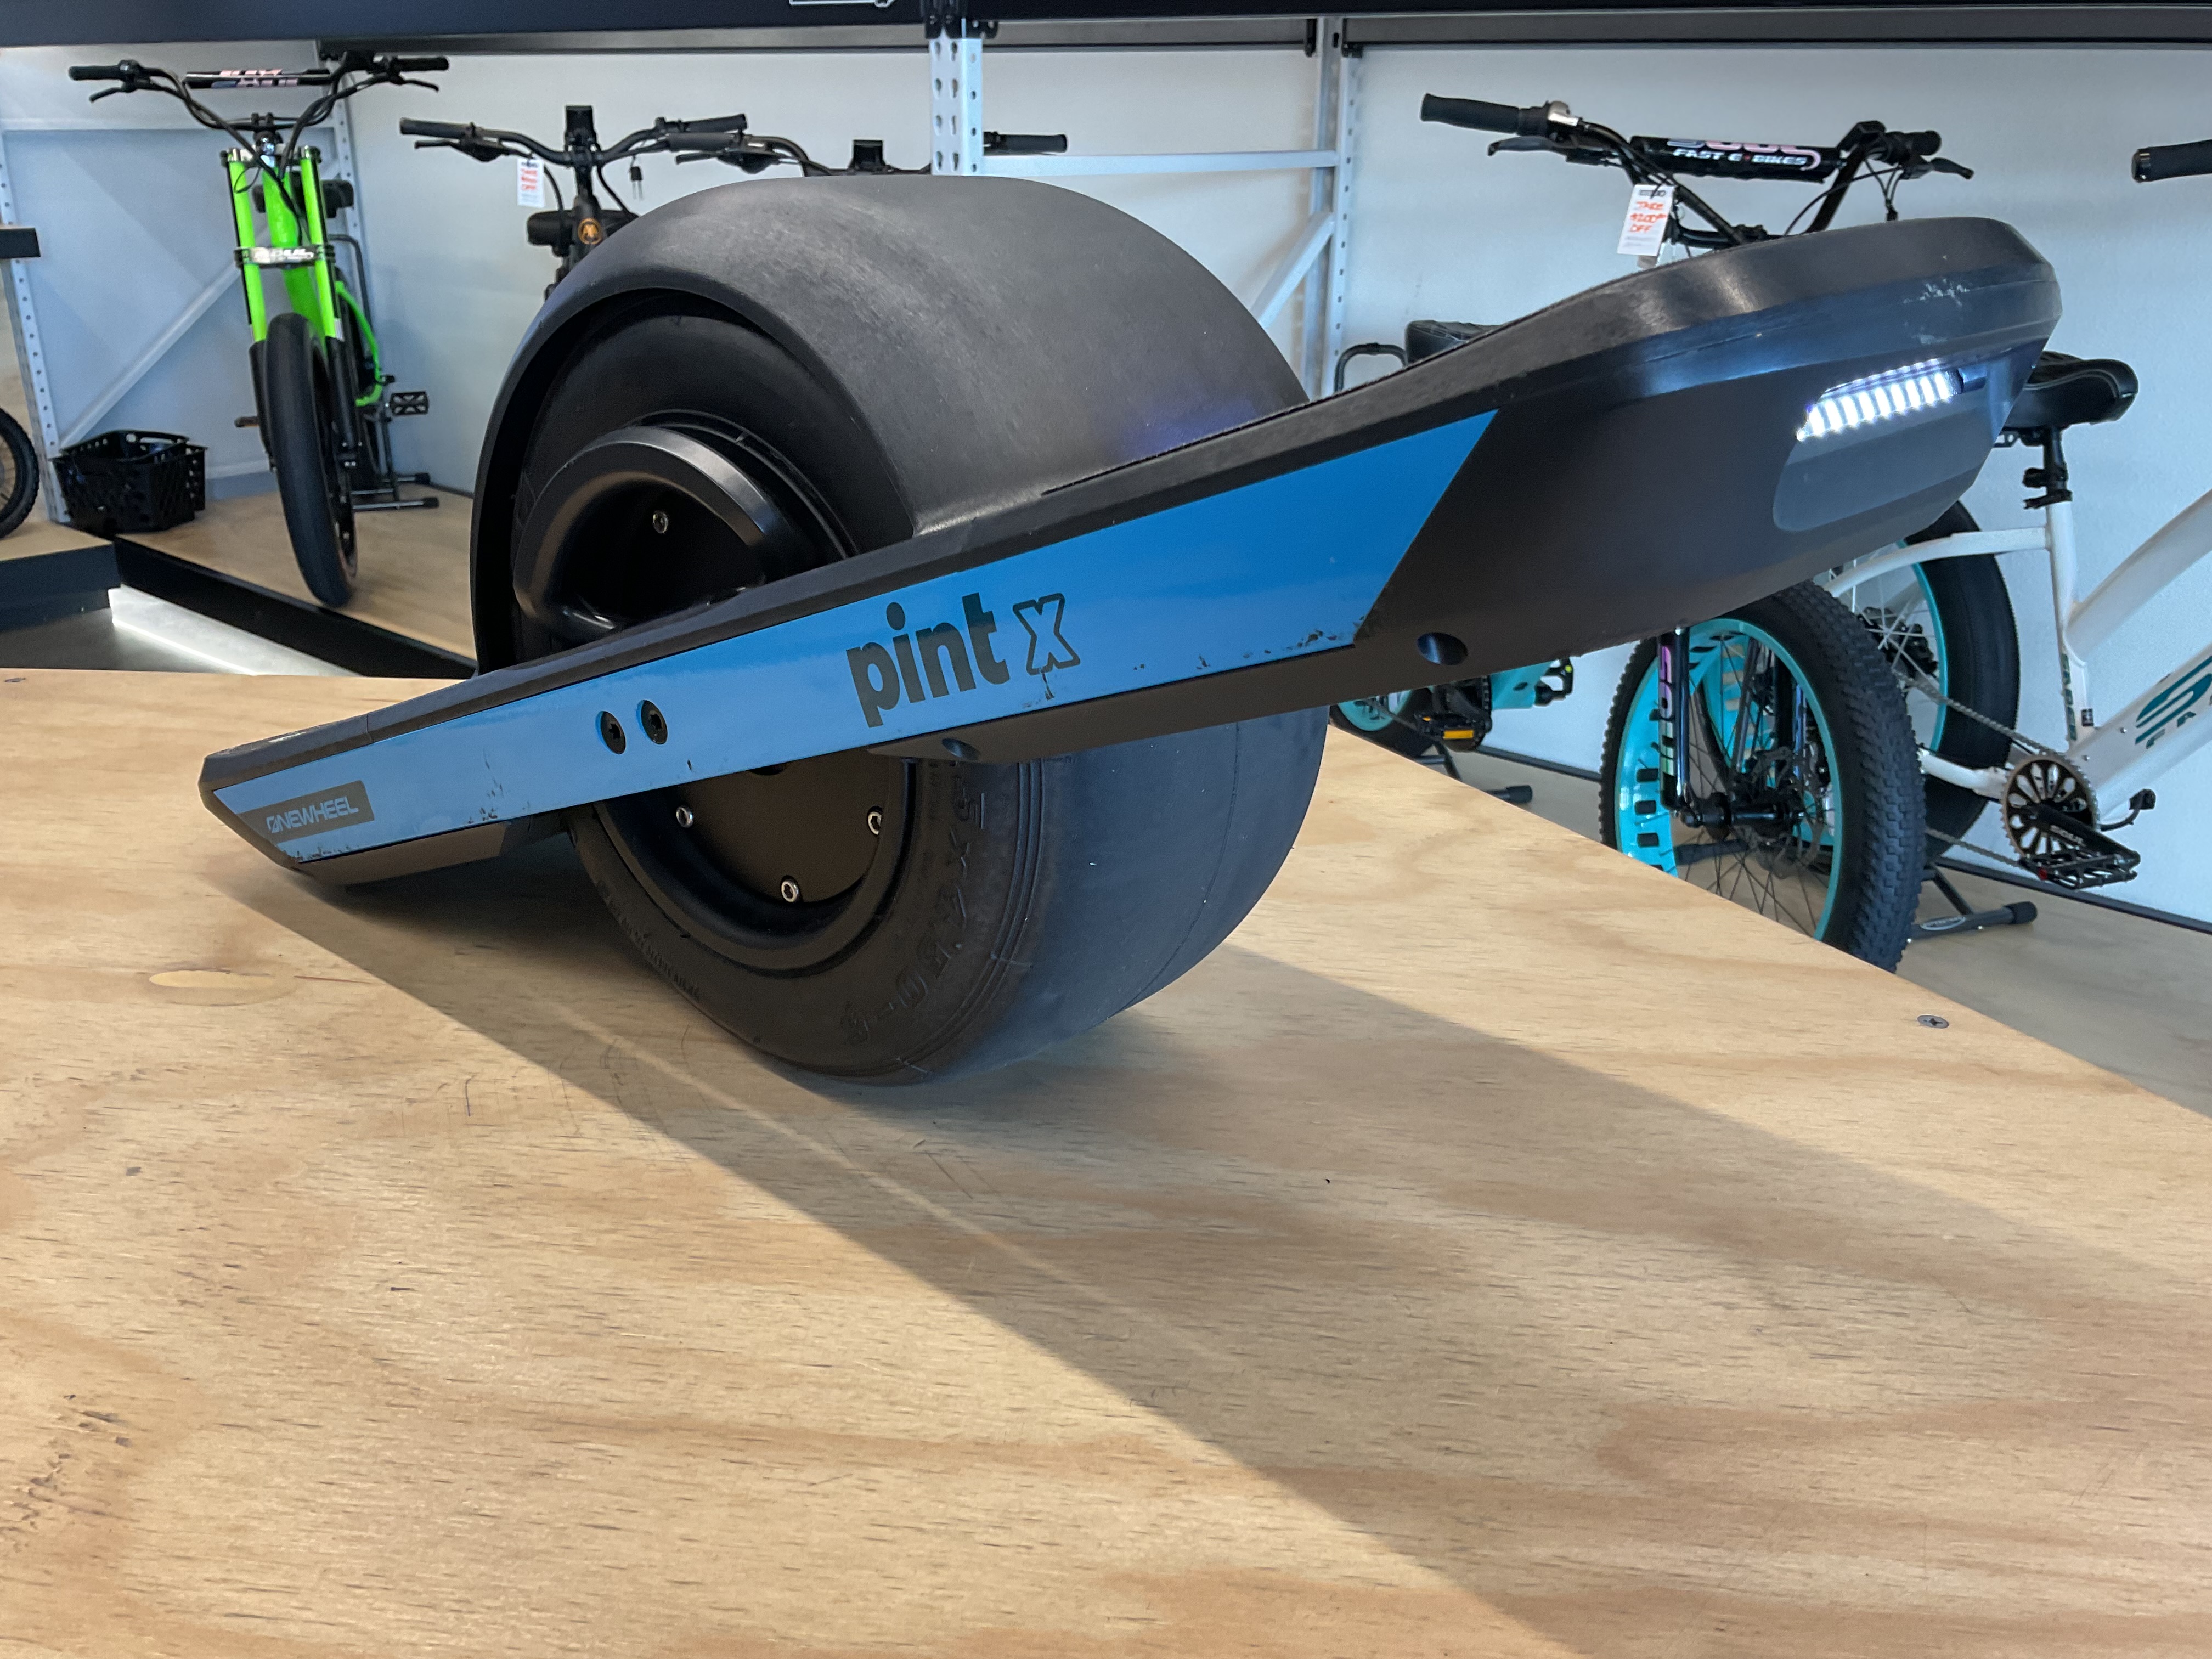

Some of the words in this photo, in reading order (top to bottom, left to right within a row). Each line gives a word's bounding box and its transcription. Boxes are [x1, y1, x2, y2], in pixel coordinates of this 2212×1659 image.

[1673, 148, 1725, 160] FAST
[846, 592, 1011, 729] pint
[2146, 692, 2212, 749] FA
[266, 796, 359, 834] ONEWHEEL
